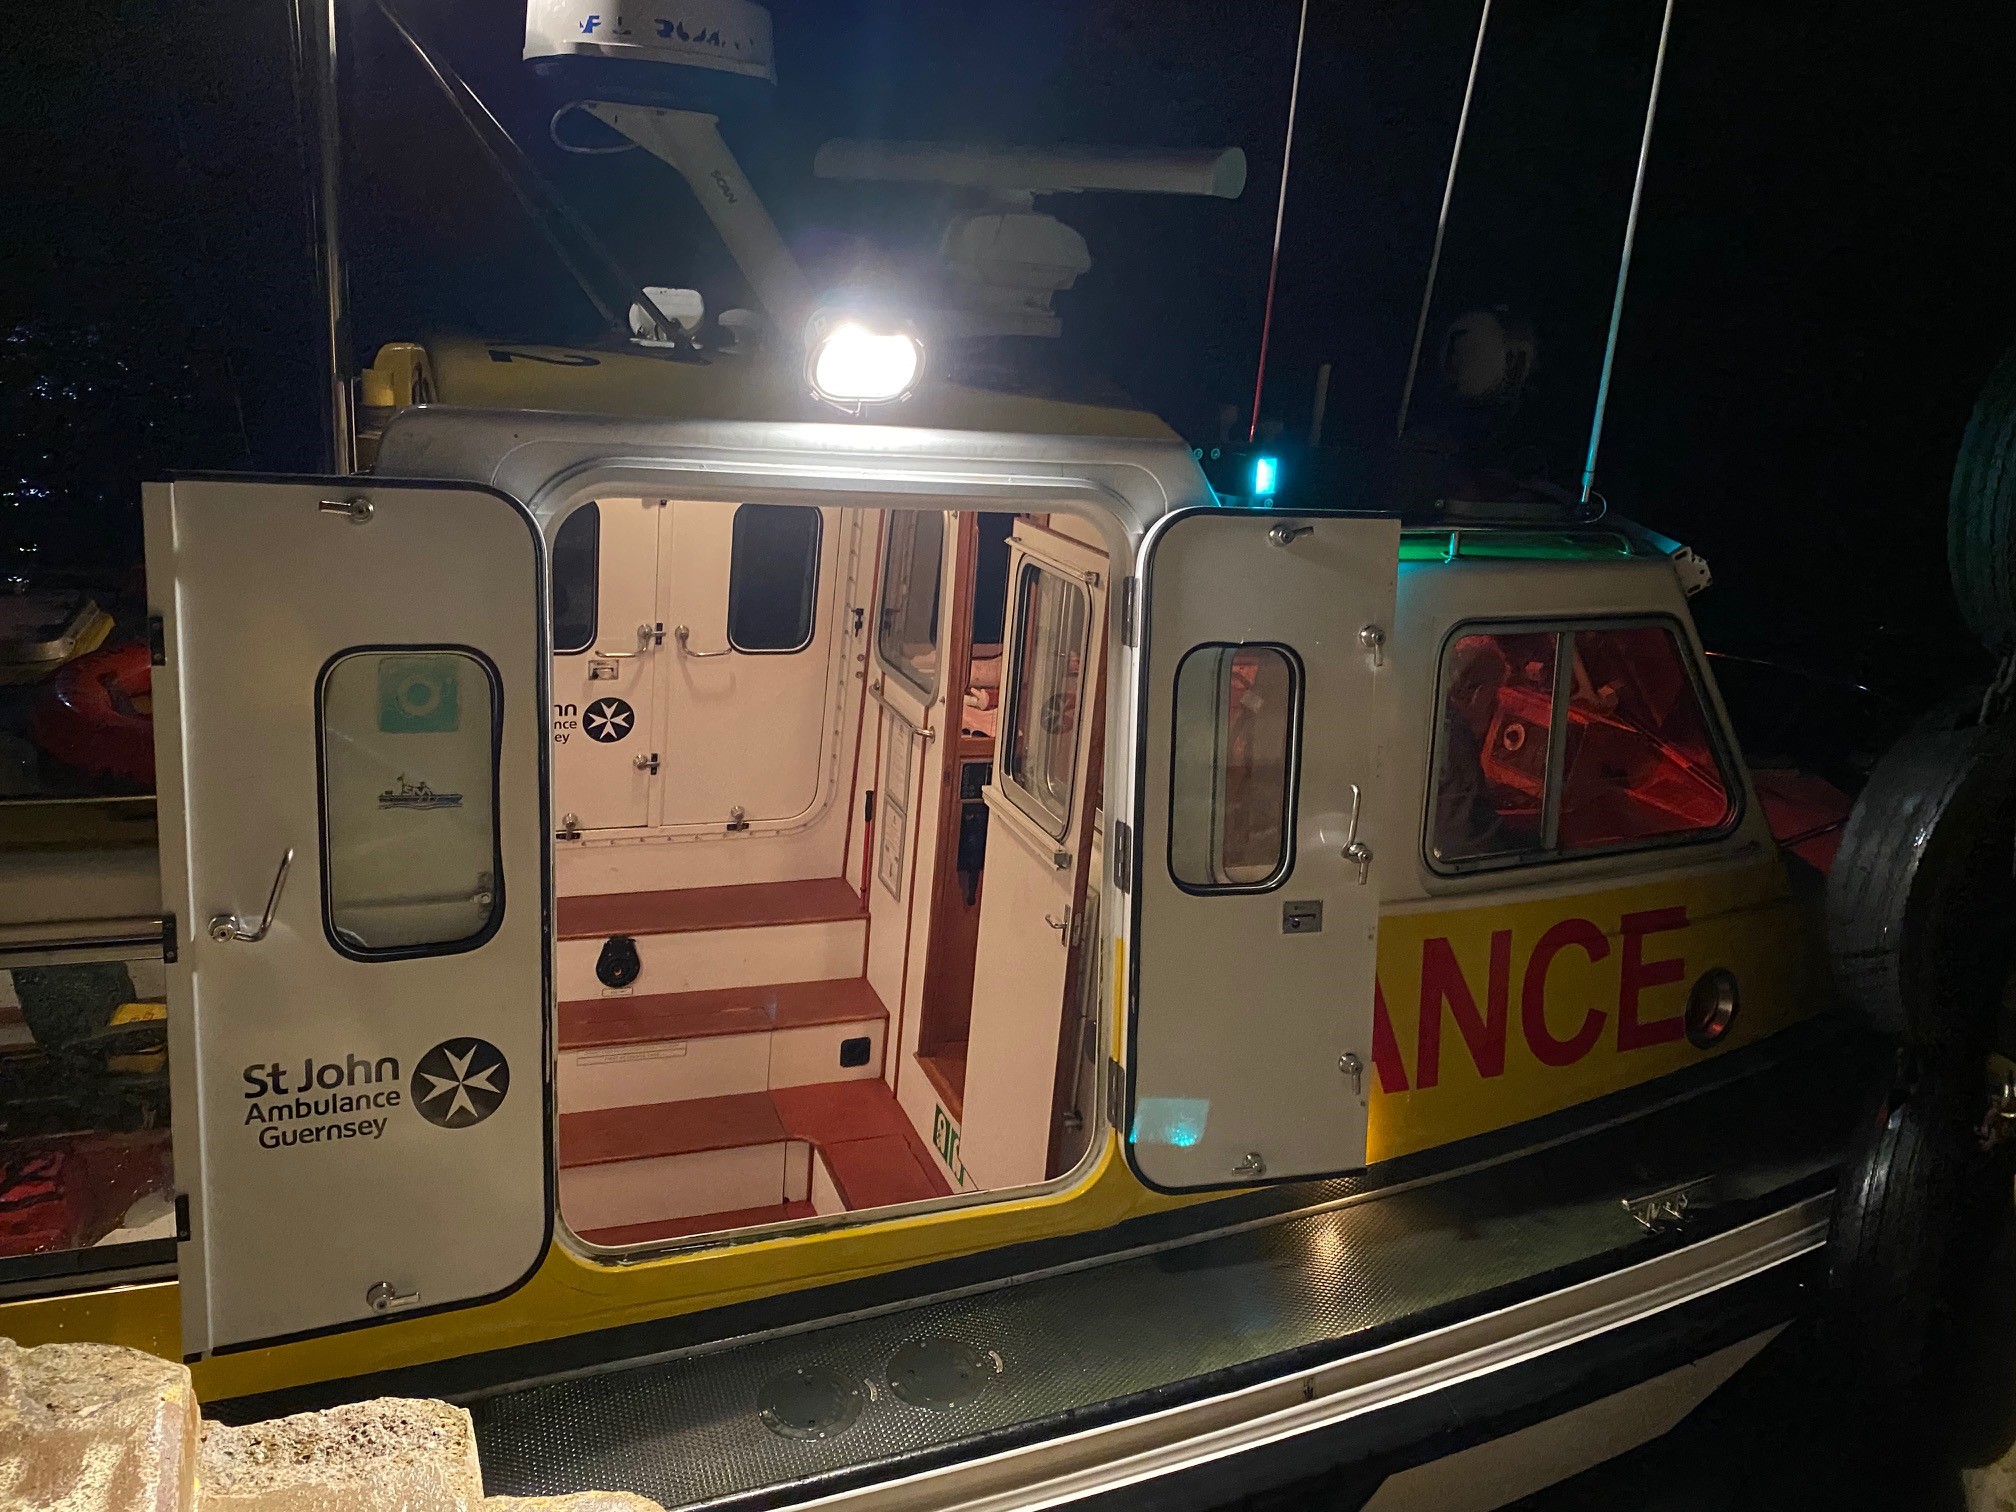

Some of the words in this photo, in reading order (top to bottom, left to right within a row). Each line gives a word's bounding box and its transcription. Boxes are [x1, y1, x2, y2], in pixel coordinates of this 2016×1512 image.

[243, 1062, 289, 1099] St
[297, 1053, 400, 1093] John
[244, 1089, 401, 1126] Ambulance
[258, 1117, 388, 1150] Guernsey
